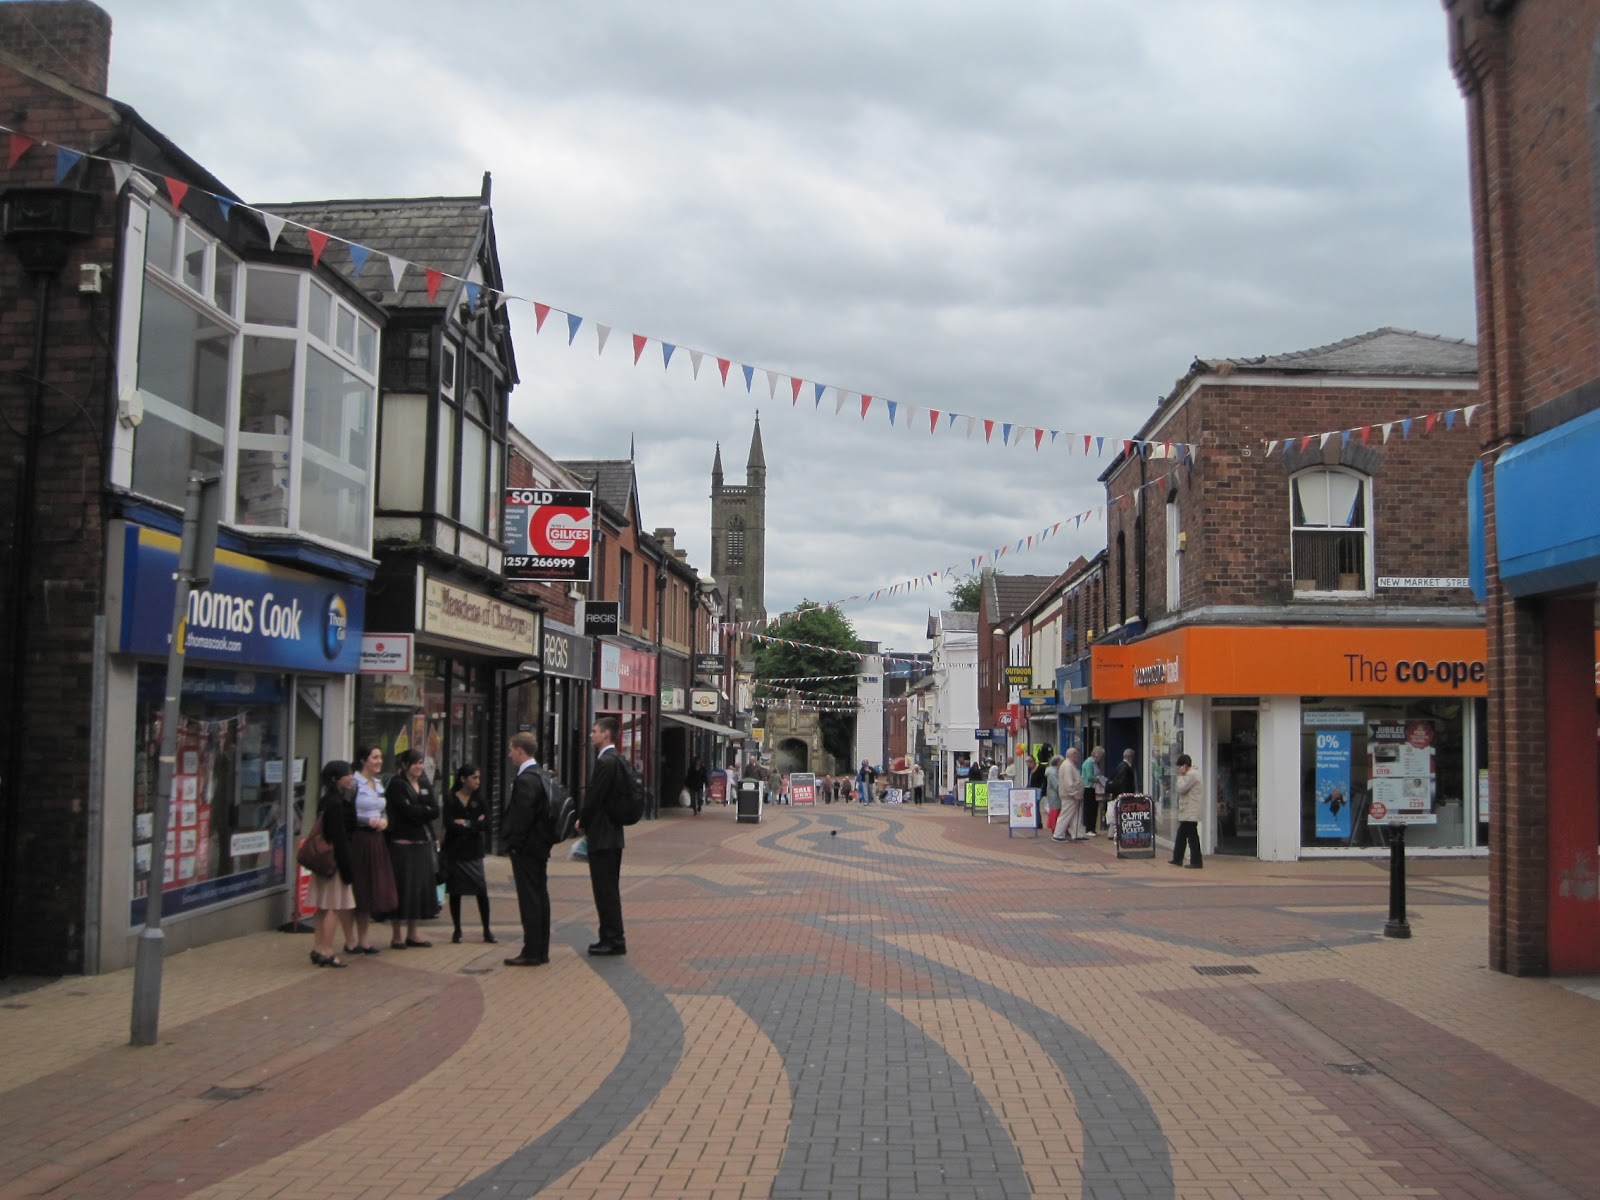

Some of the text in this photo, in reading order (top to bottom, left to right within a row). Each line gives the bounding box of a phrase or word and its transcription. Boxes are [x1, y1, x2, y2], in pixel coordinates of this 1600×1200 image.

[511, 491, 553, 505] SOLD
[550, 529, 589, 540] GILKES
[504, 556, 576, 568] 1257 266999
[1380, 578, 1469, 587] NEW MARKET STRE
[187, 589, 302, 641] homas Cook
[1005, 667, 1032, 675] OUTDOOR
[1343, 654, 1485, 689] The co-ope
[1376, 726, 1405, 734] JUBILEE
[1316, 734, 1339, 749] 0%
[793, 786, 811, 794] SALE
[1121, 811, 1150, 821] OLYMPIC
[1121, 820, 1142, 829] GAMES
[1122, 826, 1145, 834] TICKETS
